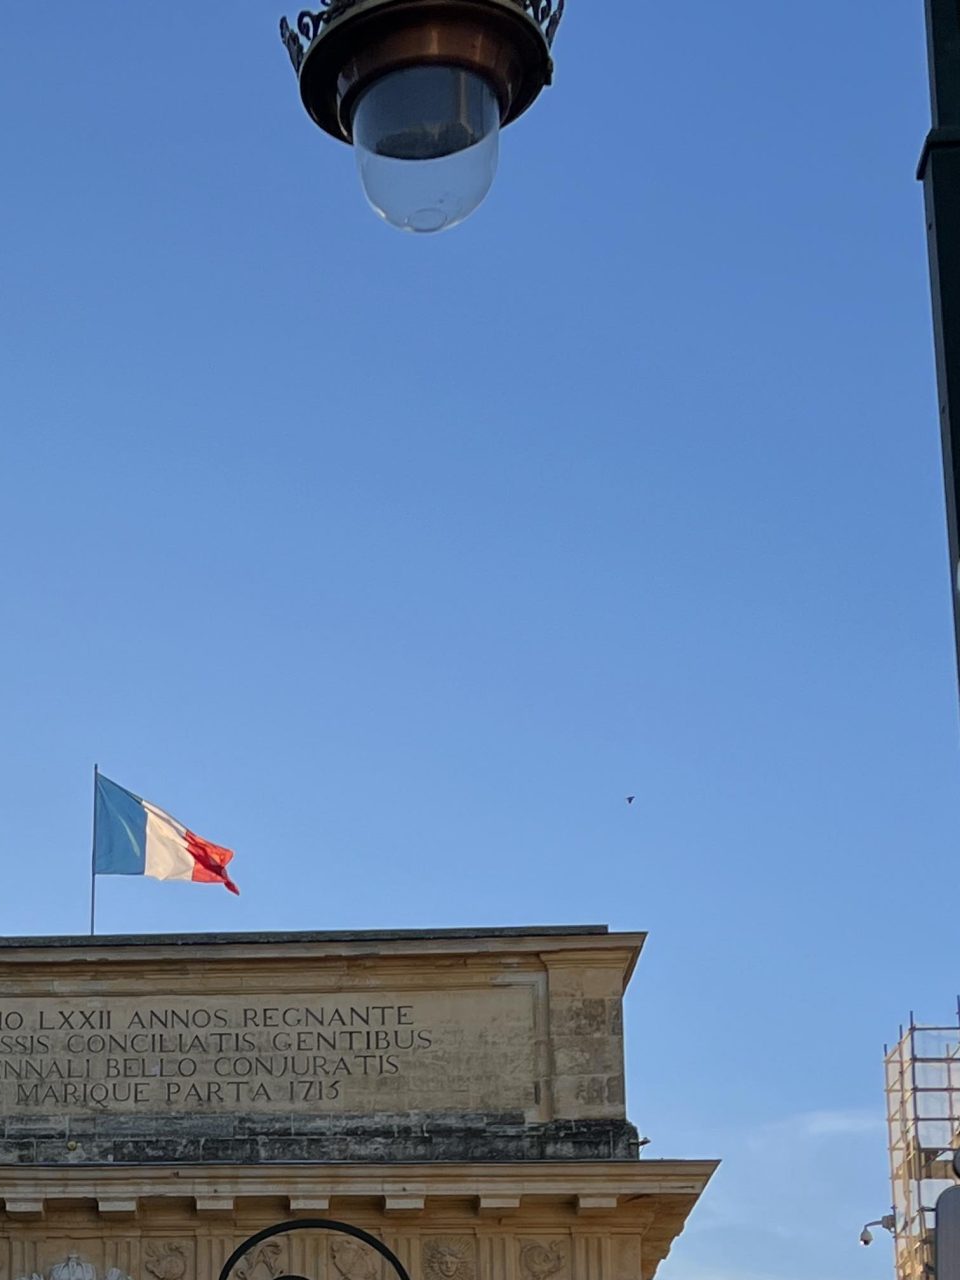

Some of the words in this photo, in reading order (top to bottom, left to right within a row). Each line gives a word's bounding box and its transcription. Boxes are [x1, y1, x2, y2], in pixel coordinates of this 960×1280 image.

[39, 1010, 112, 1031] LXXII
[127, 1008, 228, 1030] ANNOS
[243, 1005, 415, 1028] REGNANTE
[67, 1032, 256, 1054] CONCILIATIS
[272, 1029, 433, 1051] GENTIBUS
[106, 1057, 197, 1079] BELLO
[214, 1054, 400, 1078] CONJURATIS
[16, 1082, 151, 1109] MARIQUE
[166, 1080, 272, 1103] PARTA
[289, 1079, 341, 1102] 1715
